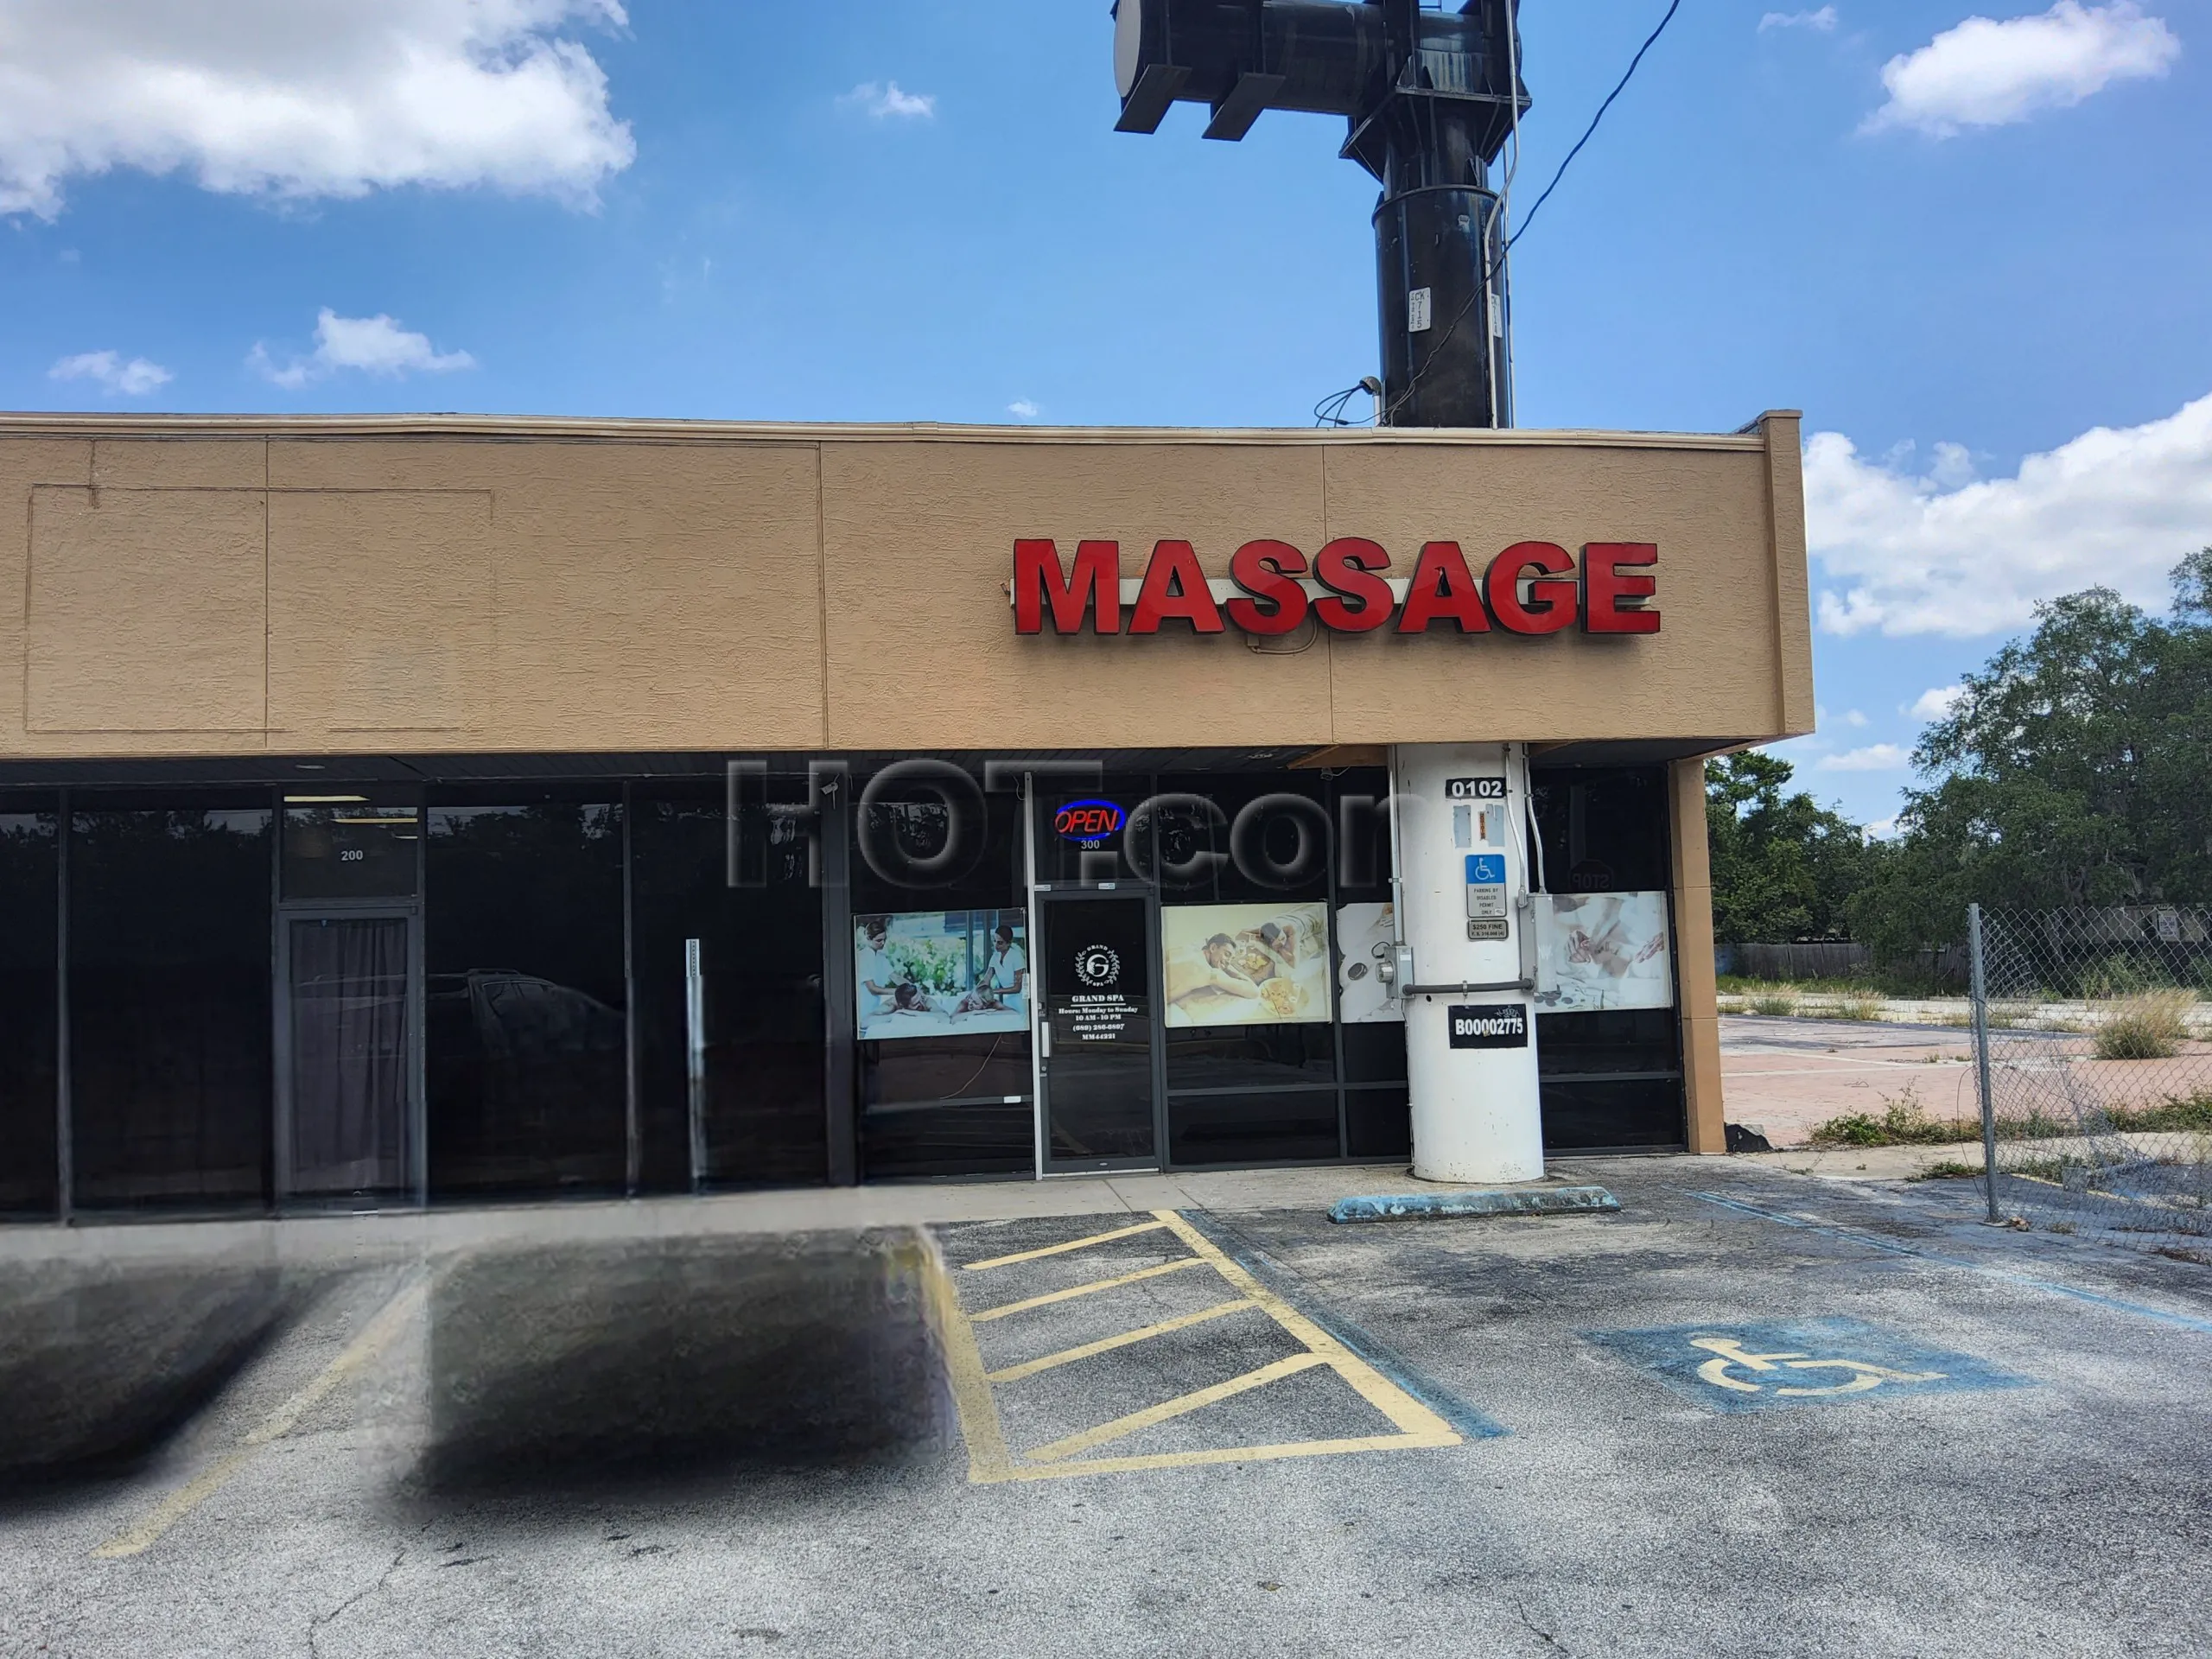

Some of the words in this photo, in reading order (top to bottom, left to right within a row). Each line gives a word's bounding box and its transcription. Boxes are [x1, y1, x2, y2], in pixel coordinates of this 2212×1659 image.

[1014, 537, 1661, 635] MASSAGE
[1451, 779, 1503, 798] 0102
[1055, 810, 1118, 833] OPEN
[1080, 839, 1100, 849] 300
[340, 849, 364, 861] 200
[1455, 1018, 1523, 1036] B00002775
